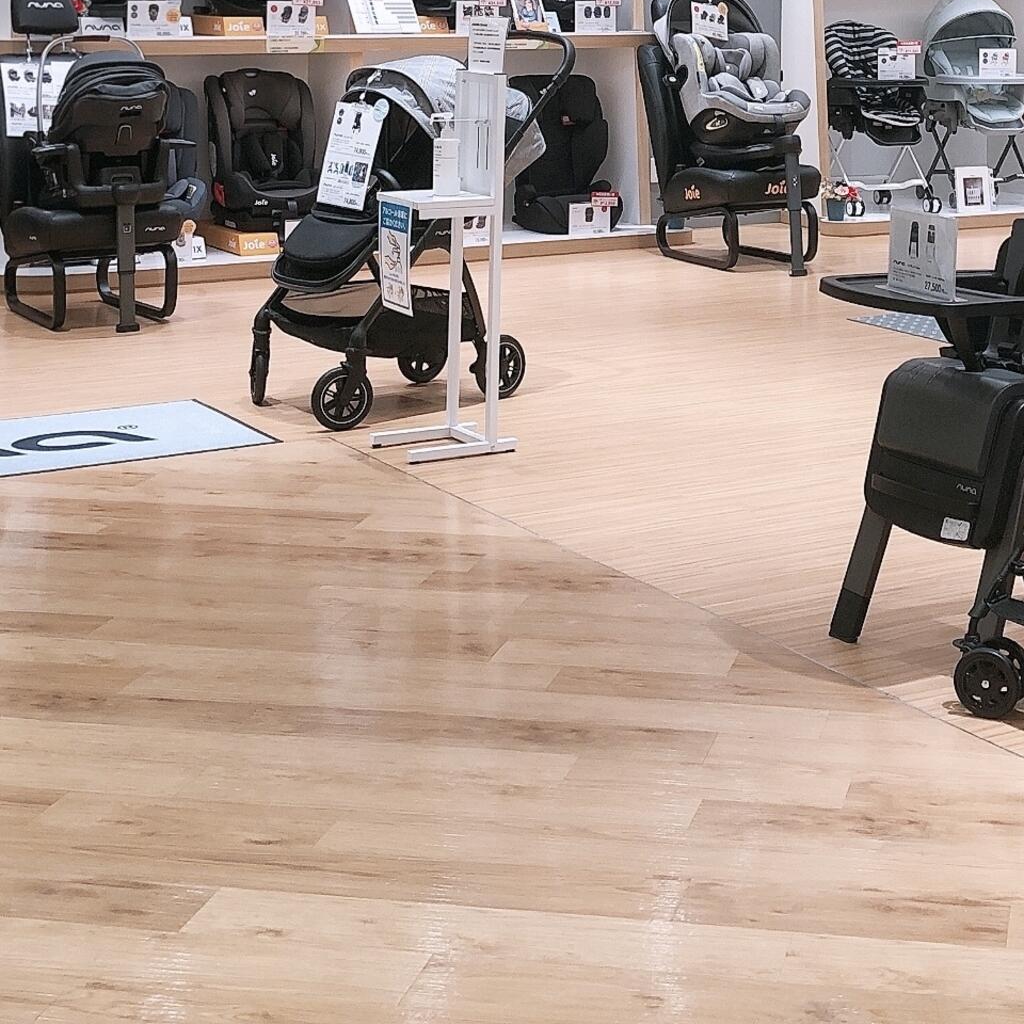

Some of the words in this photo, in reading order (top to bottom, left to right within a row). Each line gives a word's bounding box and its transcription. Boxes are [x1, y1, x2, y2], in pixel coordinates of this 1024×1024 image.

[27, 1, 65, 9] nuna
[84, 24, 122, 32] nuna
[227, 20, 251, 32] Joie
[421, 20, 437, 31] oie
[684, 184, 701, 200] Joie
[764, 179, 788, 195] Joi
[253, 198, 269, 206] Joie
[243, 239, 266, 250] Joie
[956, 483, 977, 496] nuna
